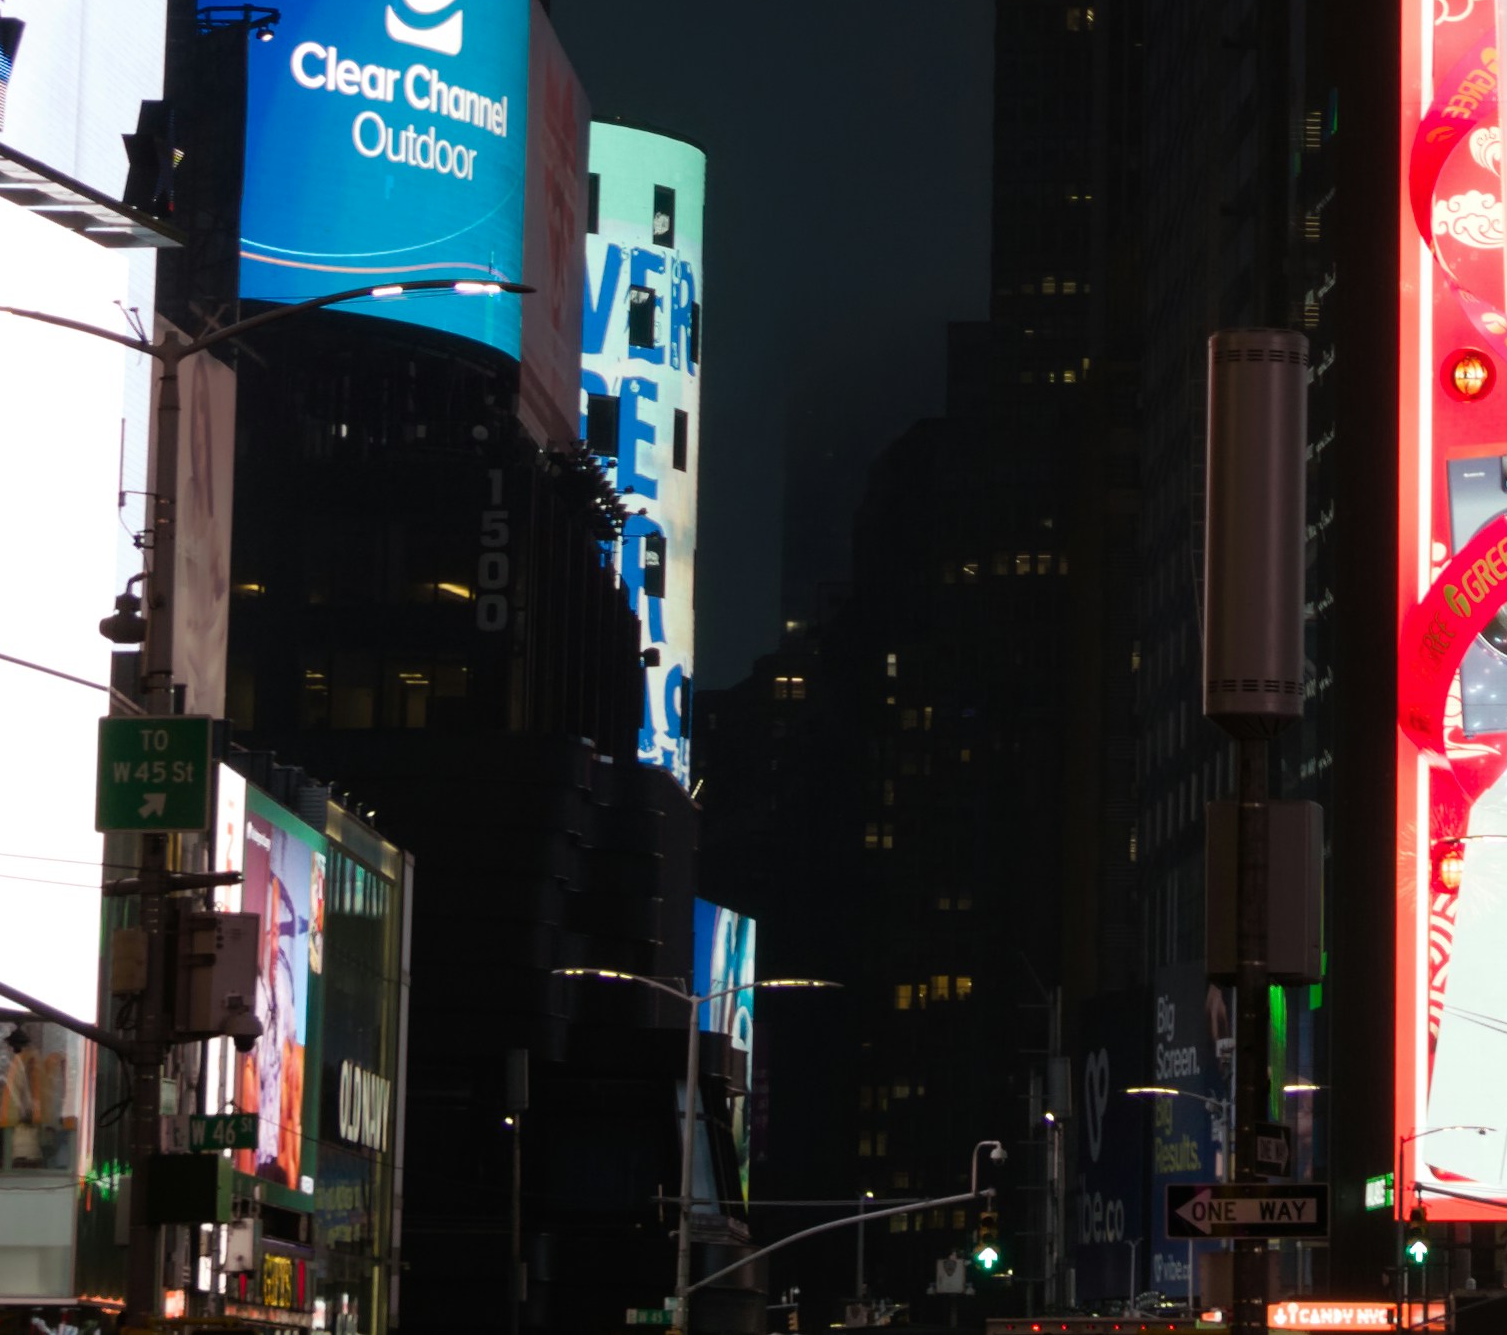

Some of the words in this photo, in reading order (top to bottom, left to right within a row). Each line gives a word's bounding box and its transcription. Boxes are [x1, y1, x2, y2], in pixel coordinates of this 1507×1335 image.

[291, 40, 403, 104] Clear
[404, 62, 509, 140] Channel
[351, 110, 479, 182] Outdoor
[475, 468, 510, 633] 1500
[140, 729, 169, 752] TO
[113, 761, 132, 784] W
[133, 761, 167, 784] 45
[172, 761, 194, 784] St
[1156, 994, 1176, 1042] Big
[1155, 1043, 1202, 1081] Screen.
[338, 1059, 362, 1144] OLD
[361, 1069, 392, 1154] NAVY
[191, 1119, 206, 1145] W
[212, 1115, 237, 1146] 46
[1155, 1137, 1202, 1174] Results.
[1193, 1201, 1237, 1222] ONE
[1259, 1201, 1307, 1222] WAY
[1299, 1308, 1354, 1325] CANDY
[1356, 1308, 1389, 1325] NYC
